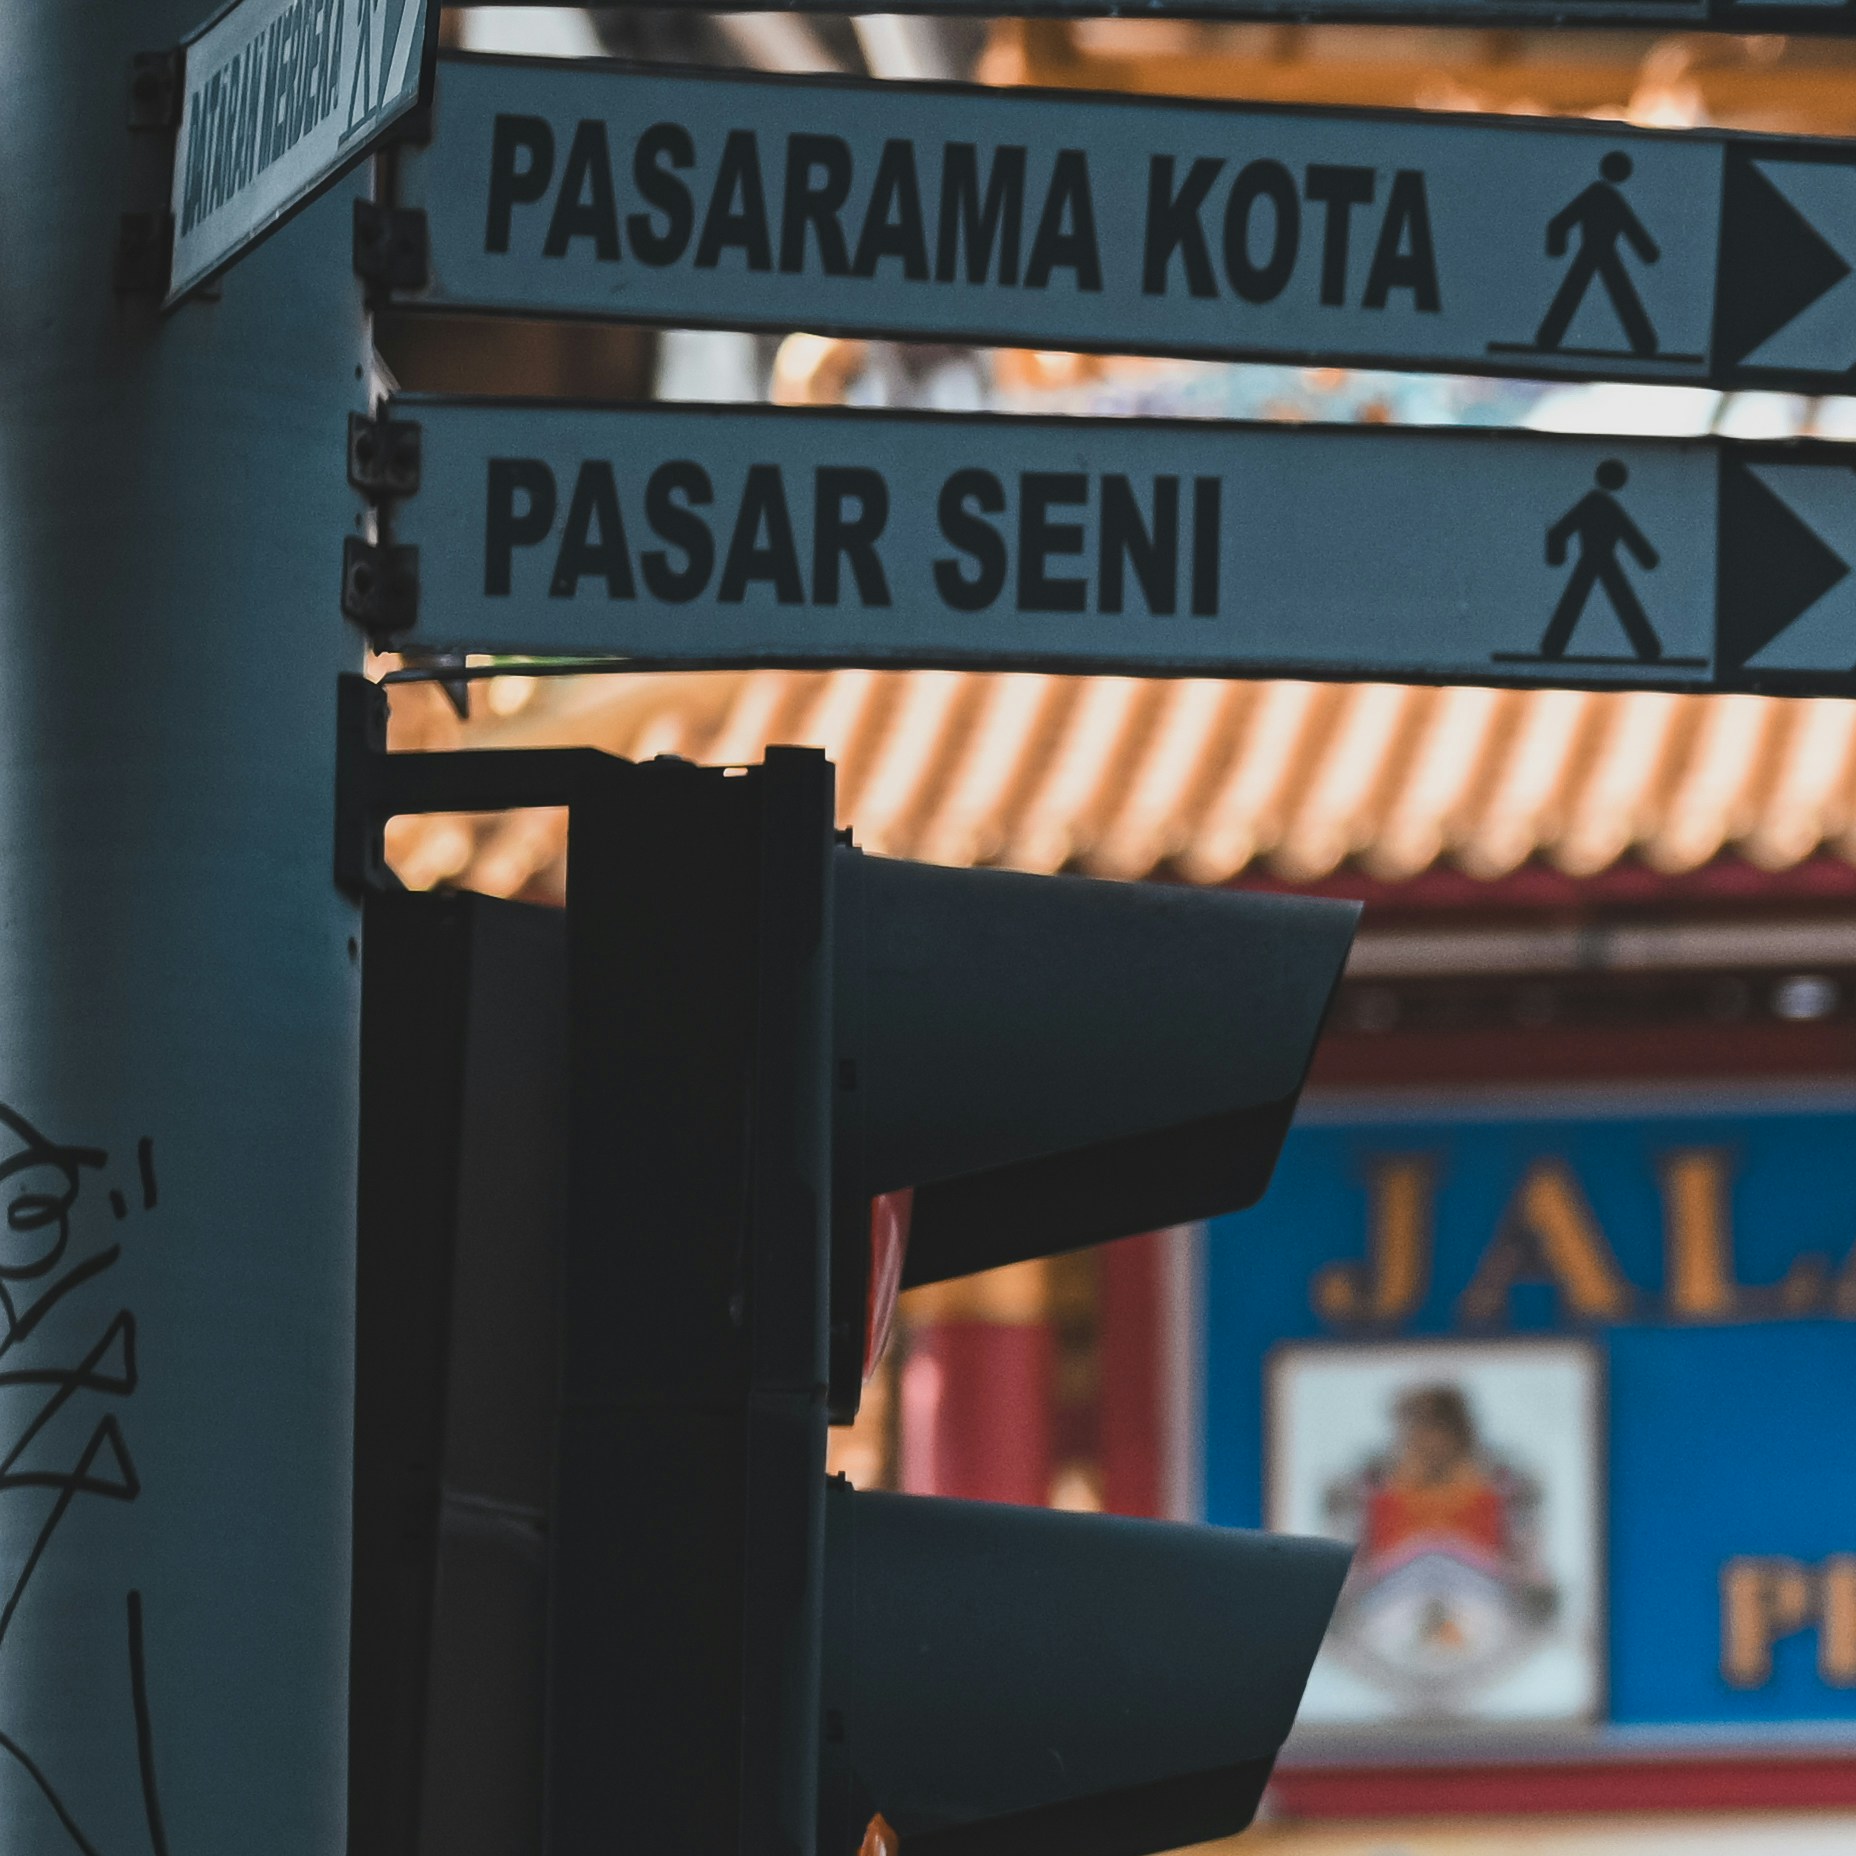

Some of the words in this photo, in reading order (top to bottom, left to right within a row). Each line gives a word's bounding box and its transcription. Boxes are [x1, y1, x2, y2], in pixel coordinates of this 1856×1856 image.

[484, 113, 1103, 292] PASARAMA
[1142, 154, 1442, 314] KOTA
[484, 457, 893, 608] PASAR
[932, 466, 1223, 618] SENI
